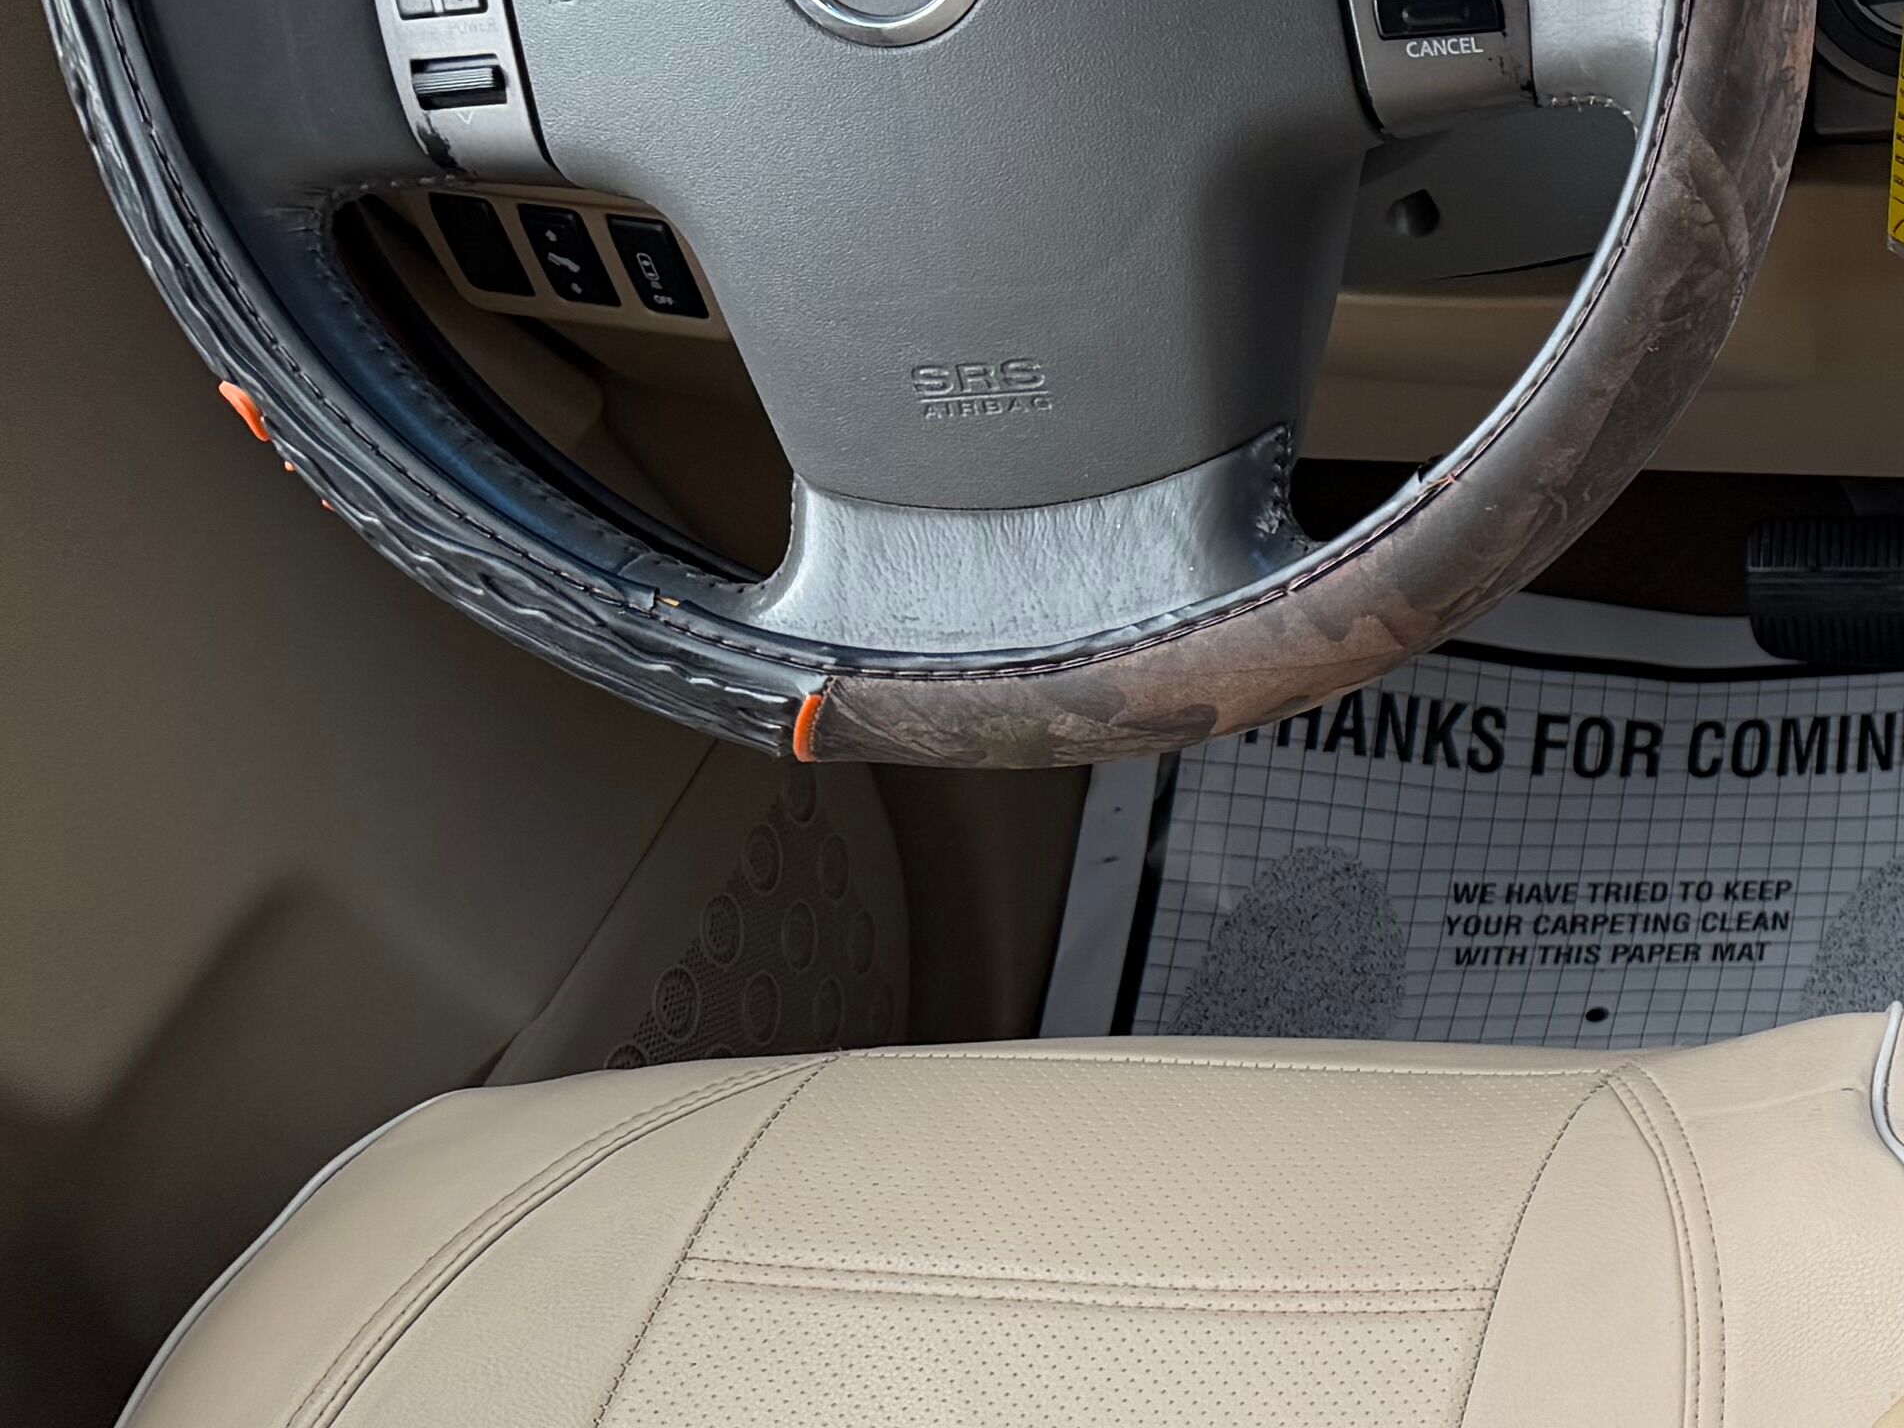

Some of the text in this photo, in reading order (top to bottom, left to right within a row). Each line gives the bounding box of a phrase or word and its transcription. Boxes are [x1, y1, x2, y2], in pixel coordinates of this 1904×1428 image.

[1406, 37, 1484, 58] CANCEL
[910, 356, 1047, 398] SRS
[923, 396, 1053, 420] AIRBAG
[1532, 712, 1665, 778] FOR
[1452, 879, 1793, 905] WE HAVE TRIED TO KEEP
[1446, 910, 1791, 937] YOUR CARPETING CLEAN
[1454, 941, 1772, 967] WITH THIS PAPER MAT
